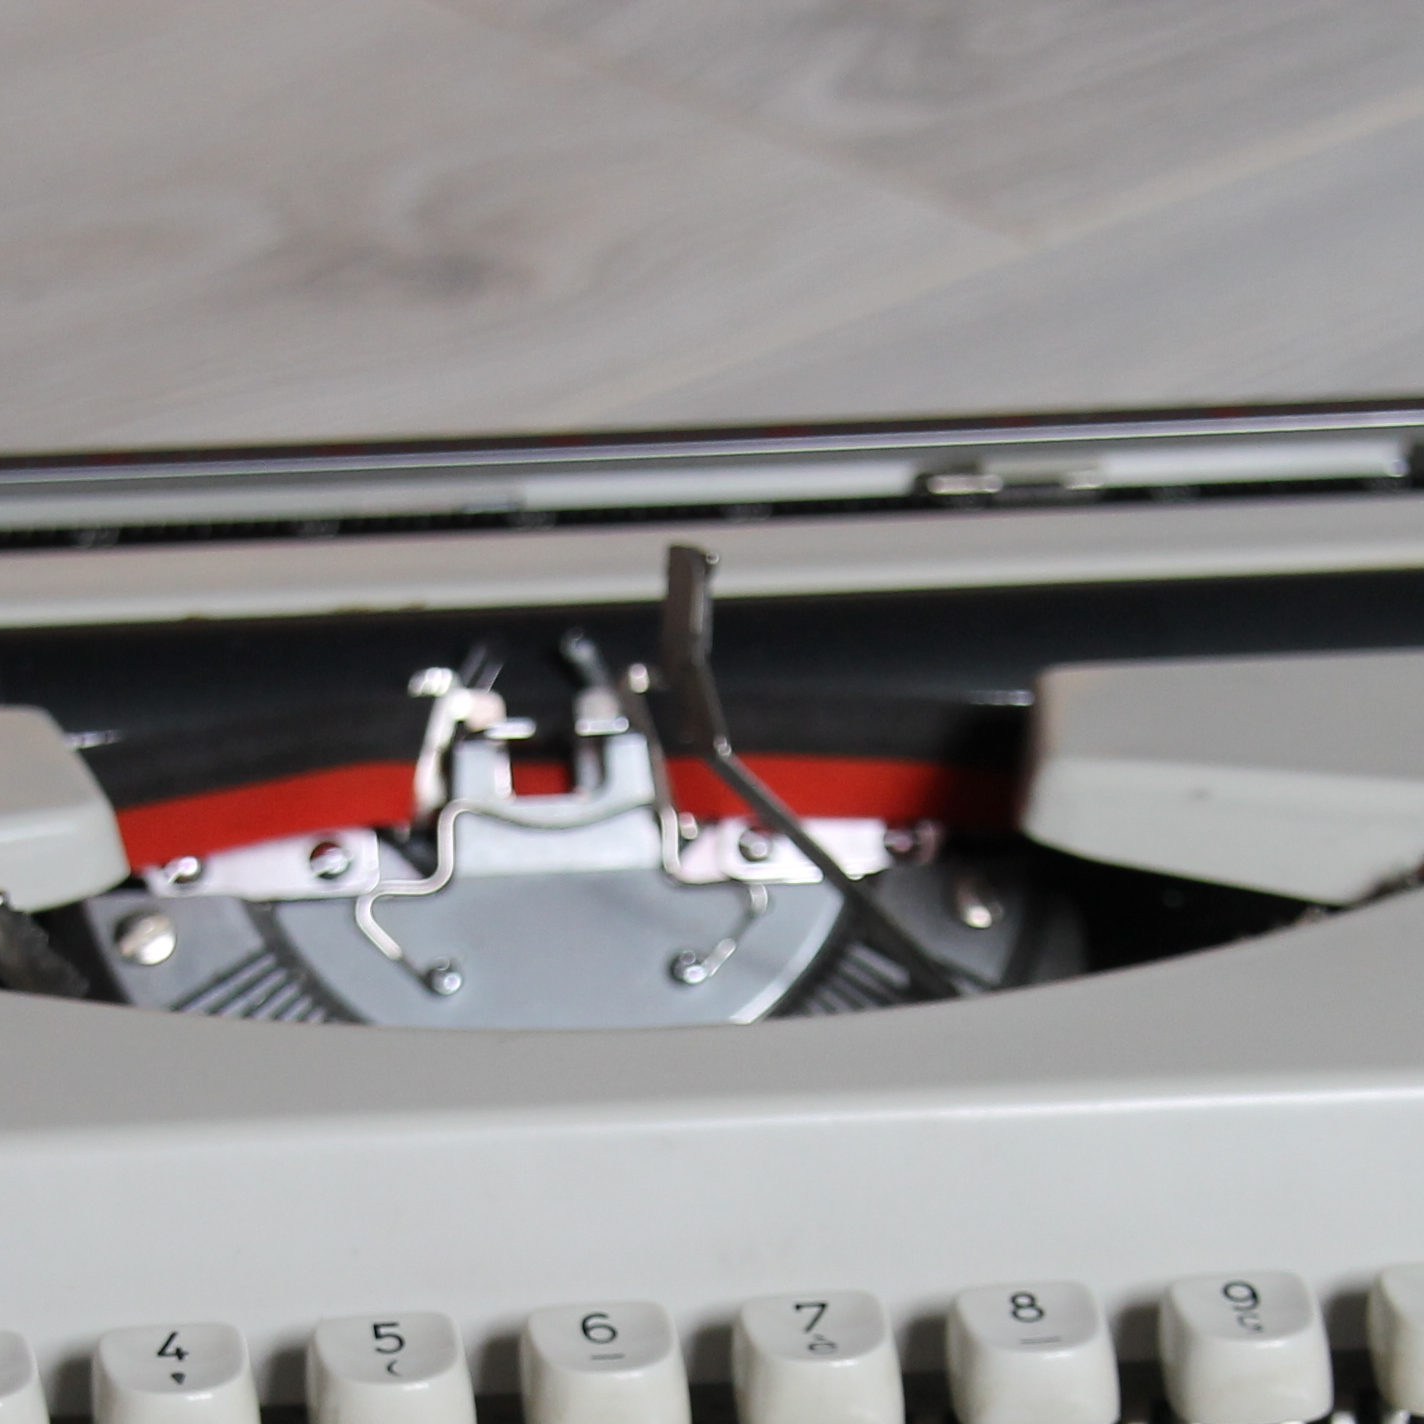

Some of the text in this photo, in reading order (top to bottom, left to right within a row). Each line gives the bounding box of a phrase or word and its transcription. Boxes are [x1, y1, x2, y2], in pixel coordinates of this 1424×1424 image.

[1010, 1290, 1045, 1323] 8
[1221, 1279, 1260, 1312] 9
[581, 1312, 619, 1344] 6
[794, 1301, 828, 1333] 7
[156, 1330, 189, 1361] 4
[372, 1321, 406, 1354] 5
